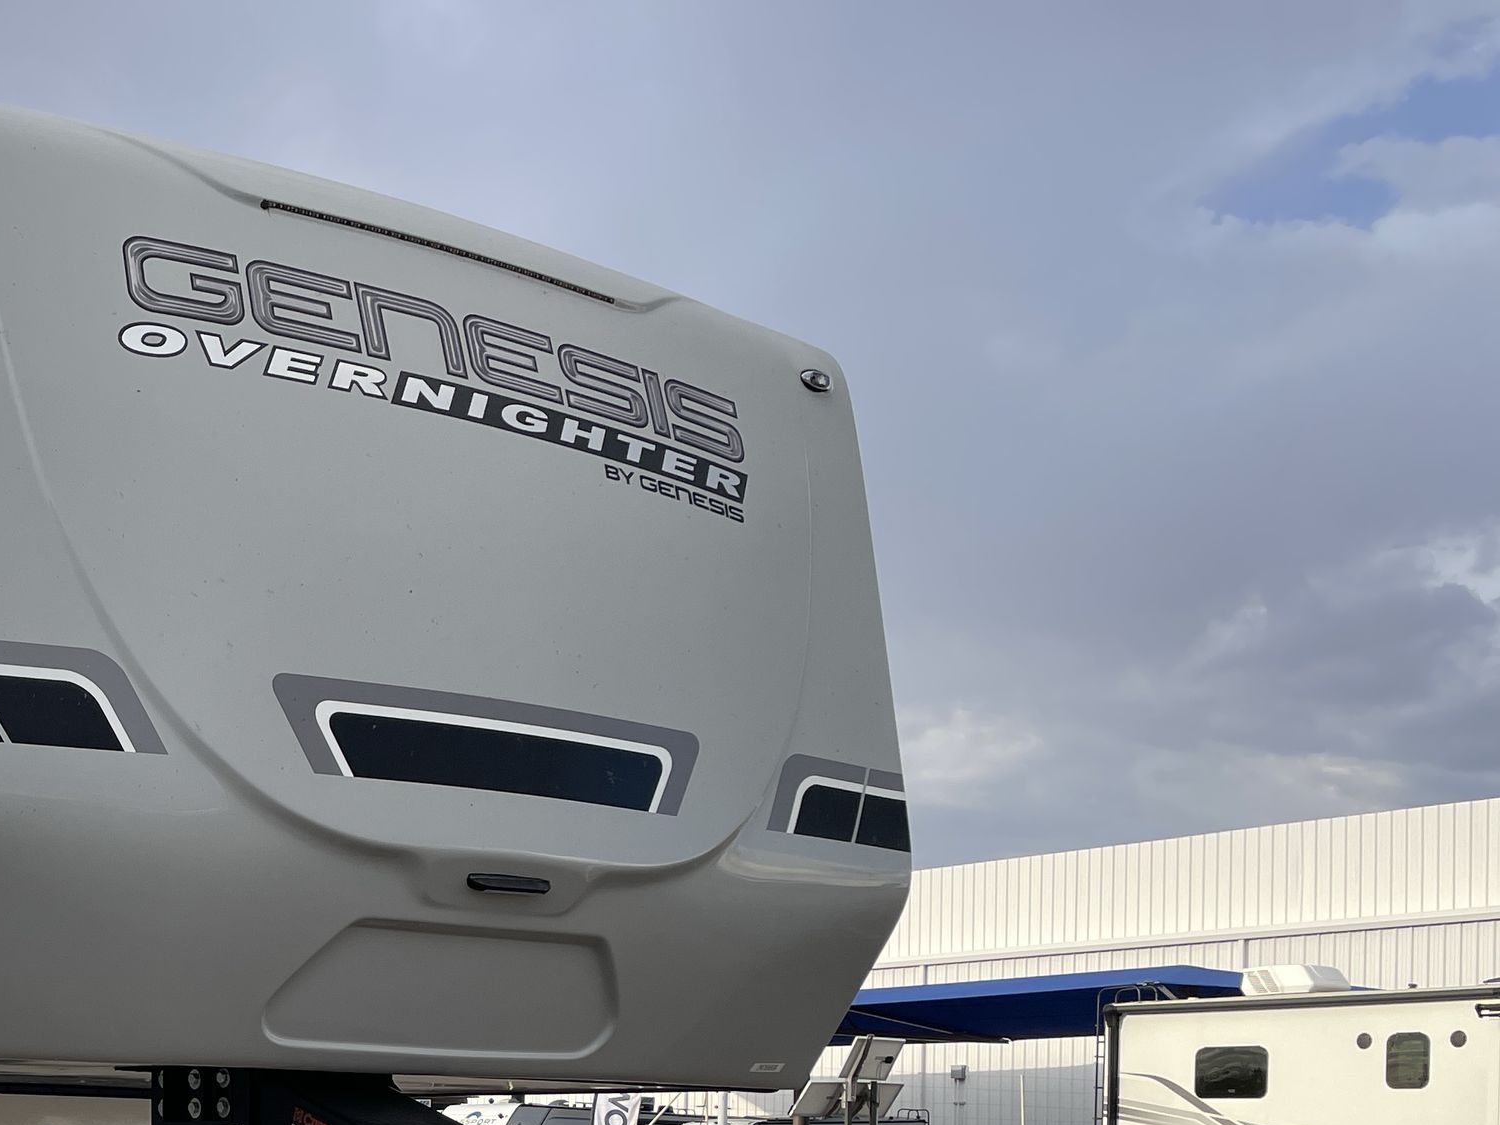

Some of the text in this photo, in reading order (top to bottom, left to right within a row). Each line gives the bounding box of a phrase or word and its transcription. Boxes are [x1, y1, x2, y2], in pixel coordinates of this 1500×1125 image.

[117, 322, 745, 501] OVERNIGHTER
[122, 235, 745, 464] GENESIS
[603, 463, 745, 524] BY GENESIS
